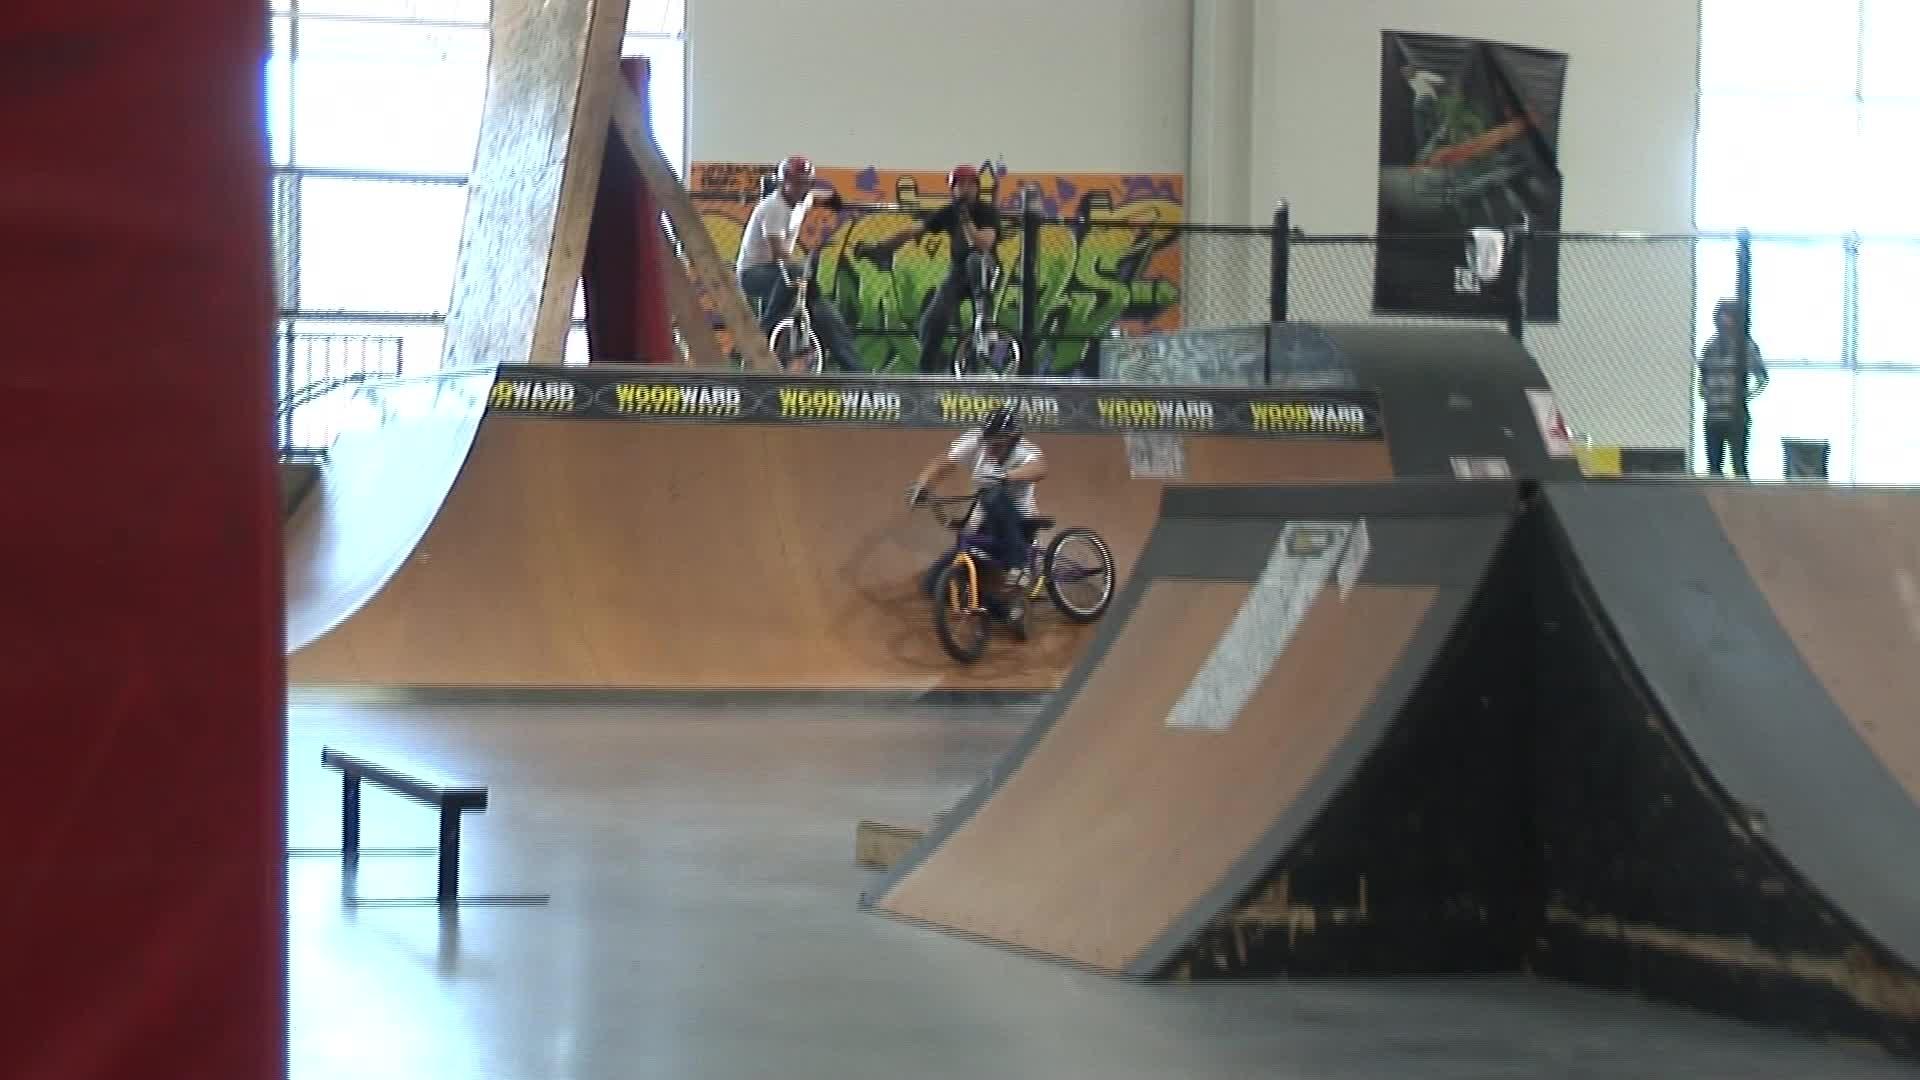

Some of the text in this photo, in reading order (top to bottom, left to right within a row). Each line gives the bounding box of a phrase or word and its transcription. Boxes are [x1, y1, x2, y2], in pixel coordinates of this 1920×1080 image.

[616, 384, 741, 411] WOODWARD
[779, 388, 899, 415] WOODWARD
[1097, 399, 1214, 425] WOODWARD
[1251, 402, 1365, 428] WOODWARD
